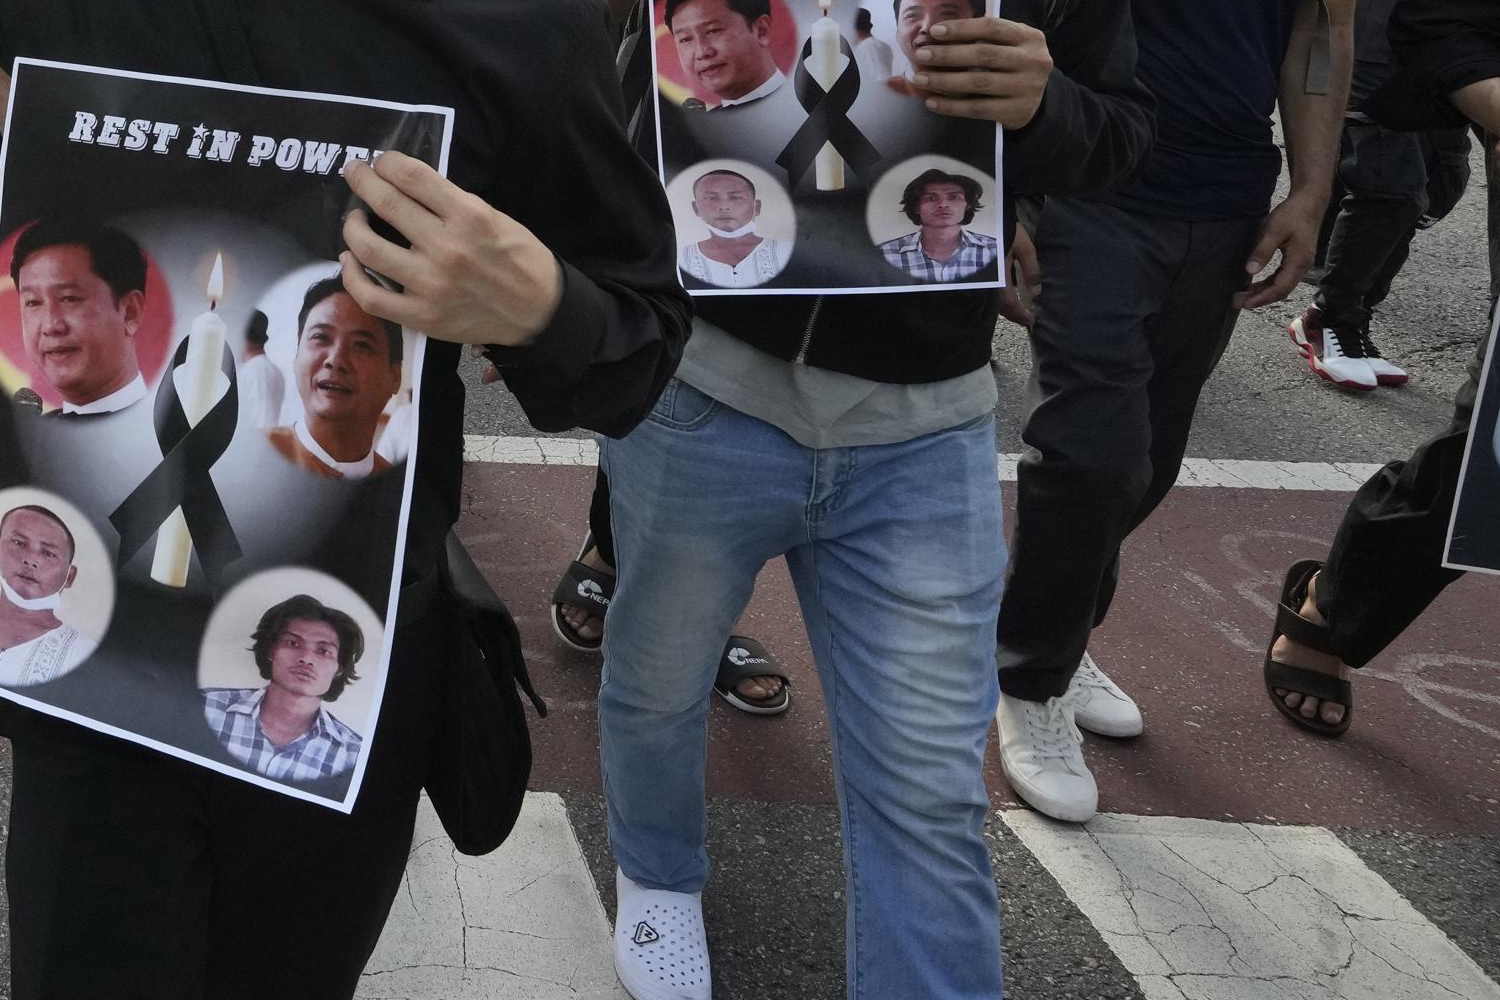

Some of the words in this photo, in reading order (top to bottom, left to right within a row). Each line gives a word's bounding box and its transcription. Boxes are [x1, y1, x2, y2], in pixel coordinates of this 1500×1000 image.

[68, 110, 181, 155] REST
[248, 135, 384, 176] POWE
[590, 593, 611, 607] NEP
